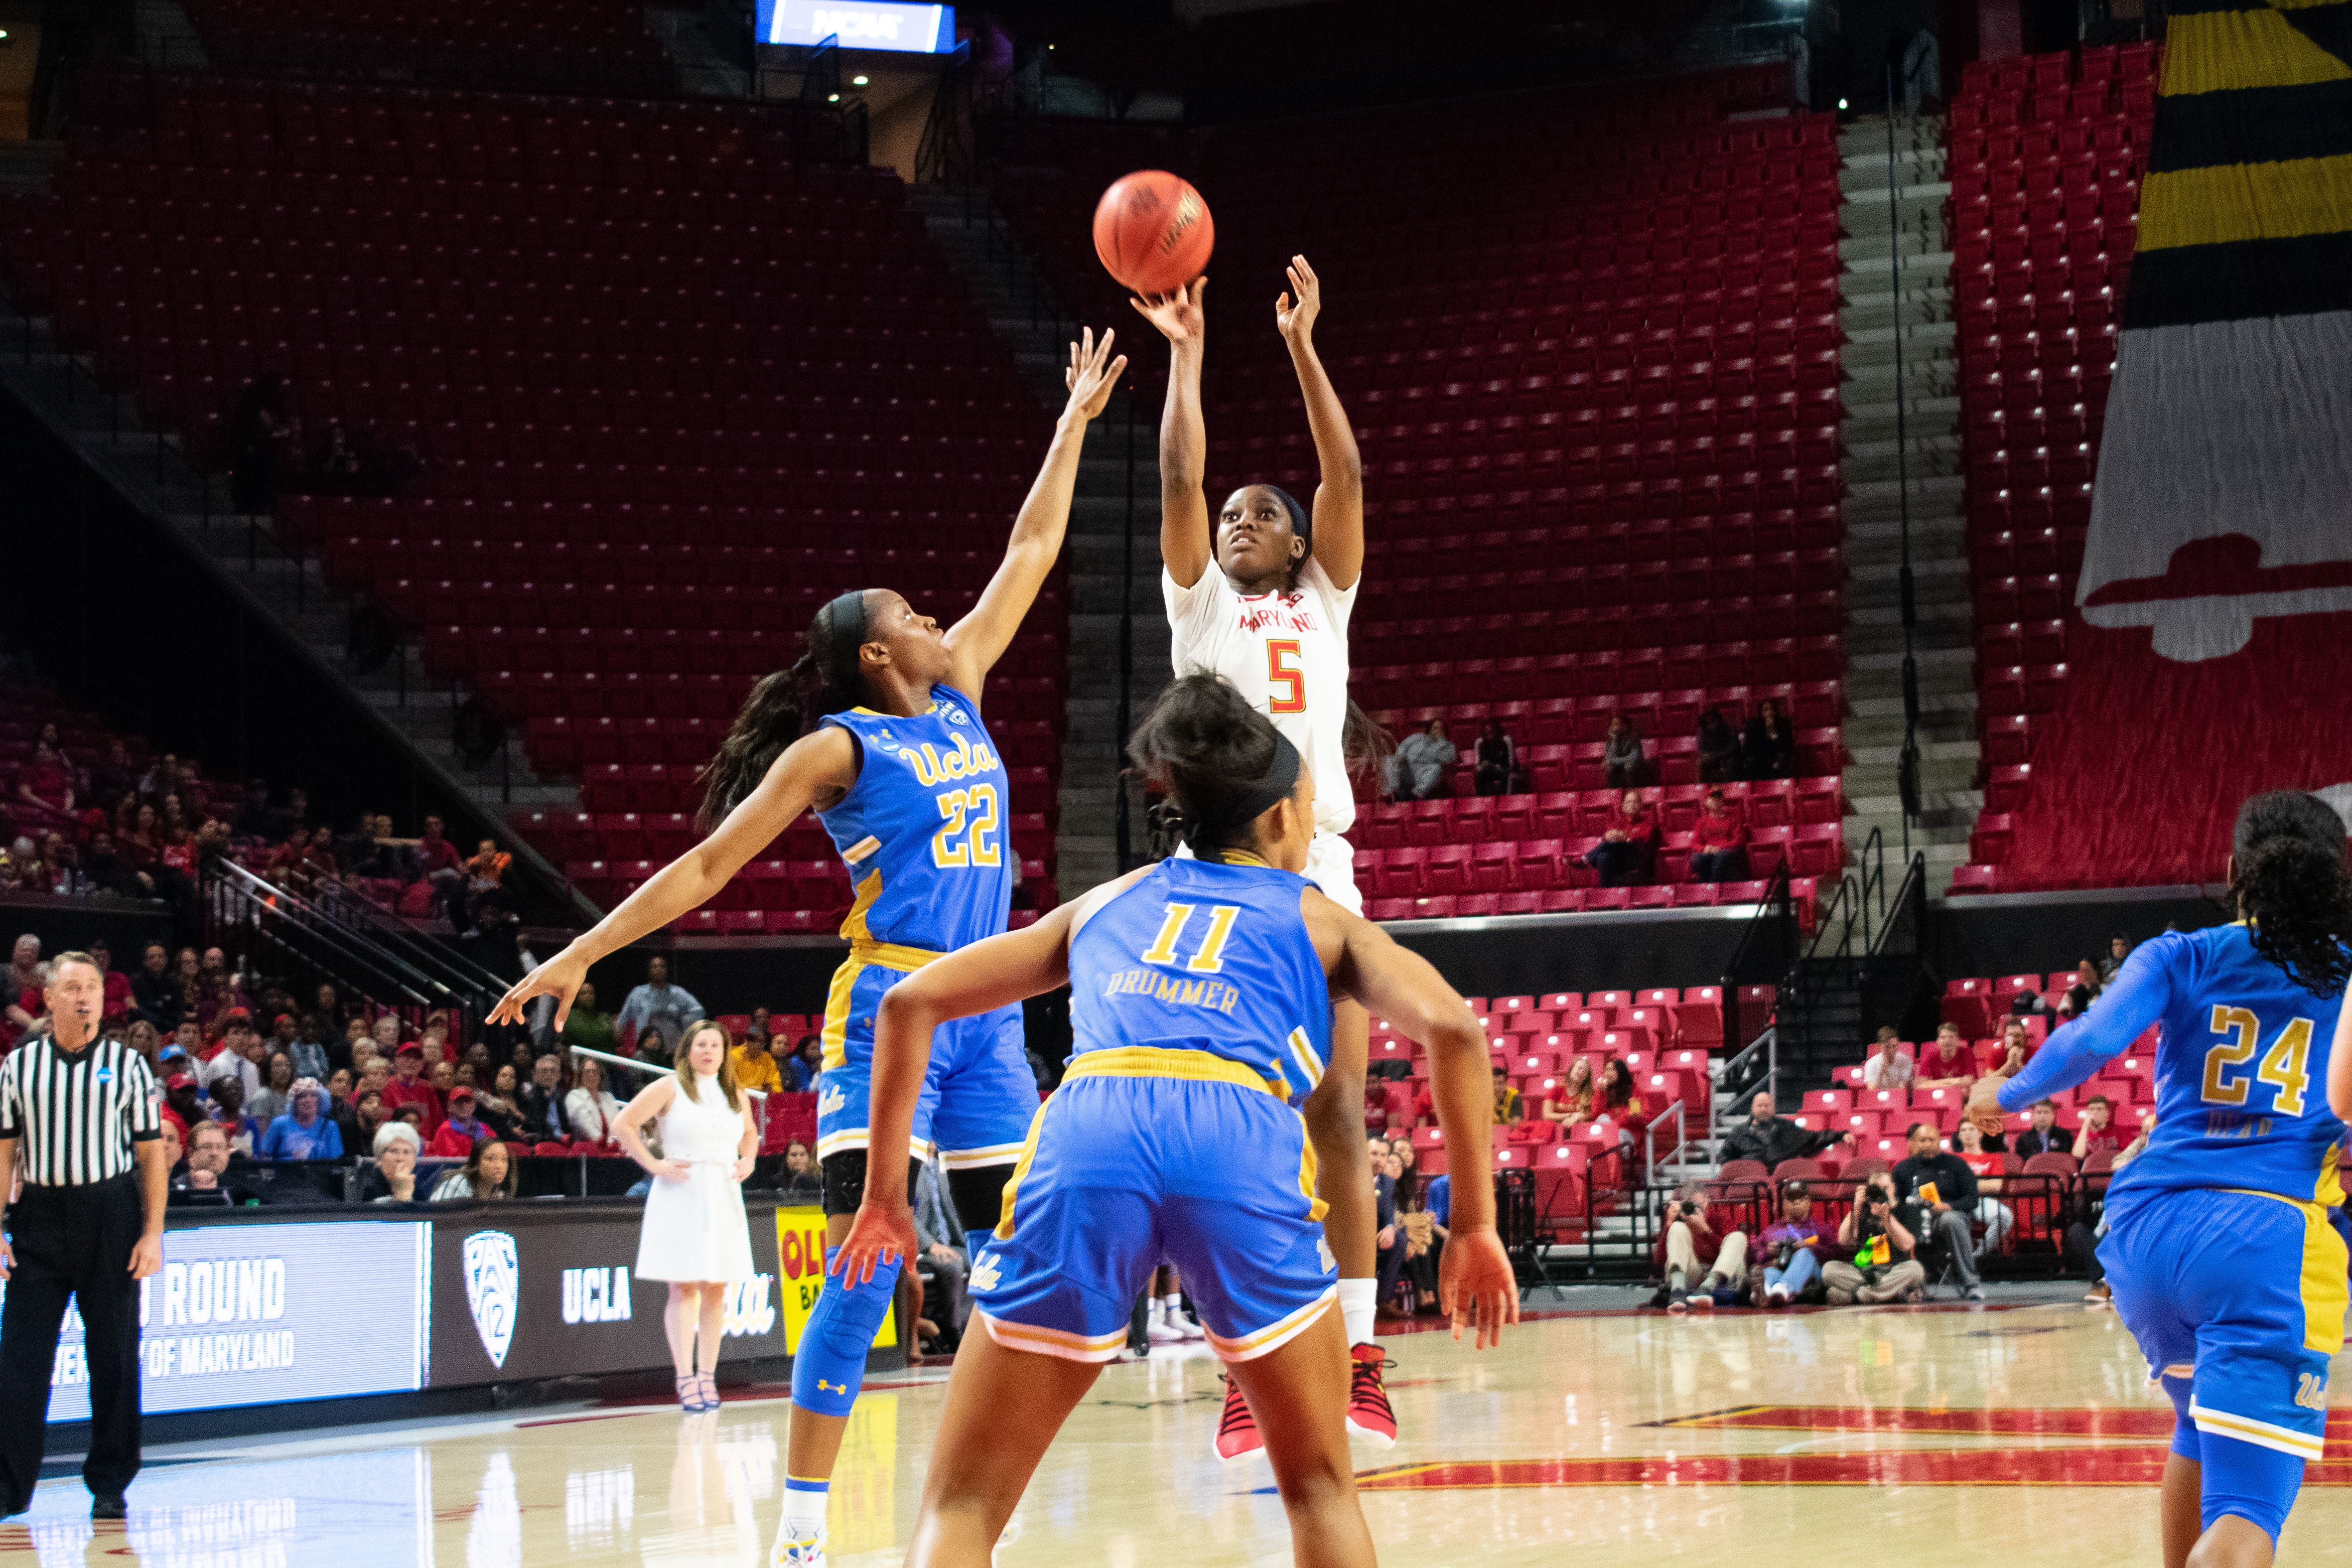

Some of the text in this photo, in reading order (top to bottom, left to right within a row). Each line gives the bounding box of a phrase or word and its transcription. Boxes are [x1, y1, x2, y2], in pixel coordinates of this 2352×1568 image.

[811, 9, 898, 40] NCAA
[1239, 610, 1318, 633] MARYLND
[1266, 639, 1306, 714] 5
[932, 783, 1002, 868] 22
[1141, 902, 1240, 973] 11
[1103, 969, 1240, 1016] DRUMMER
[2200, 1004, 2314, 1117] 24
[165, 1258, 285, 1325] ROUND
[562, 1266, 632, 1324] UCLA
[149, 1328, 295, 1377] OF MARYLAND
